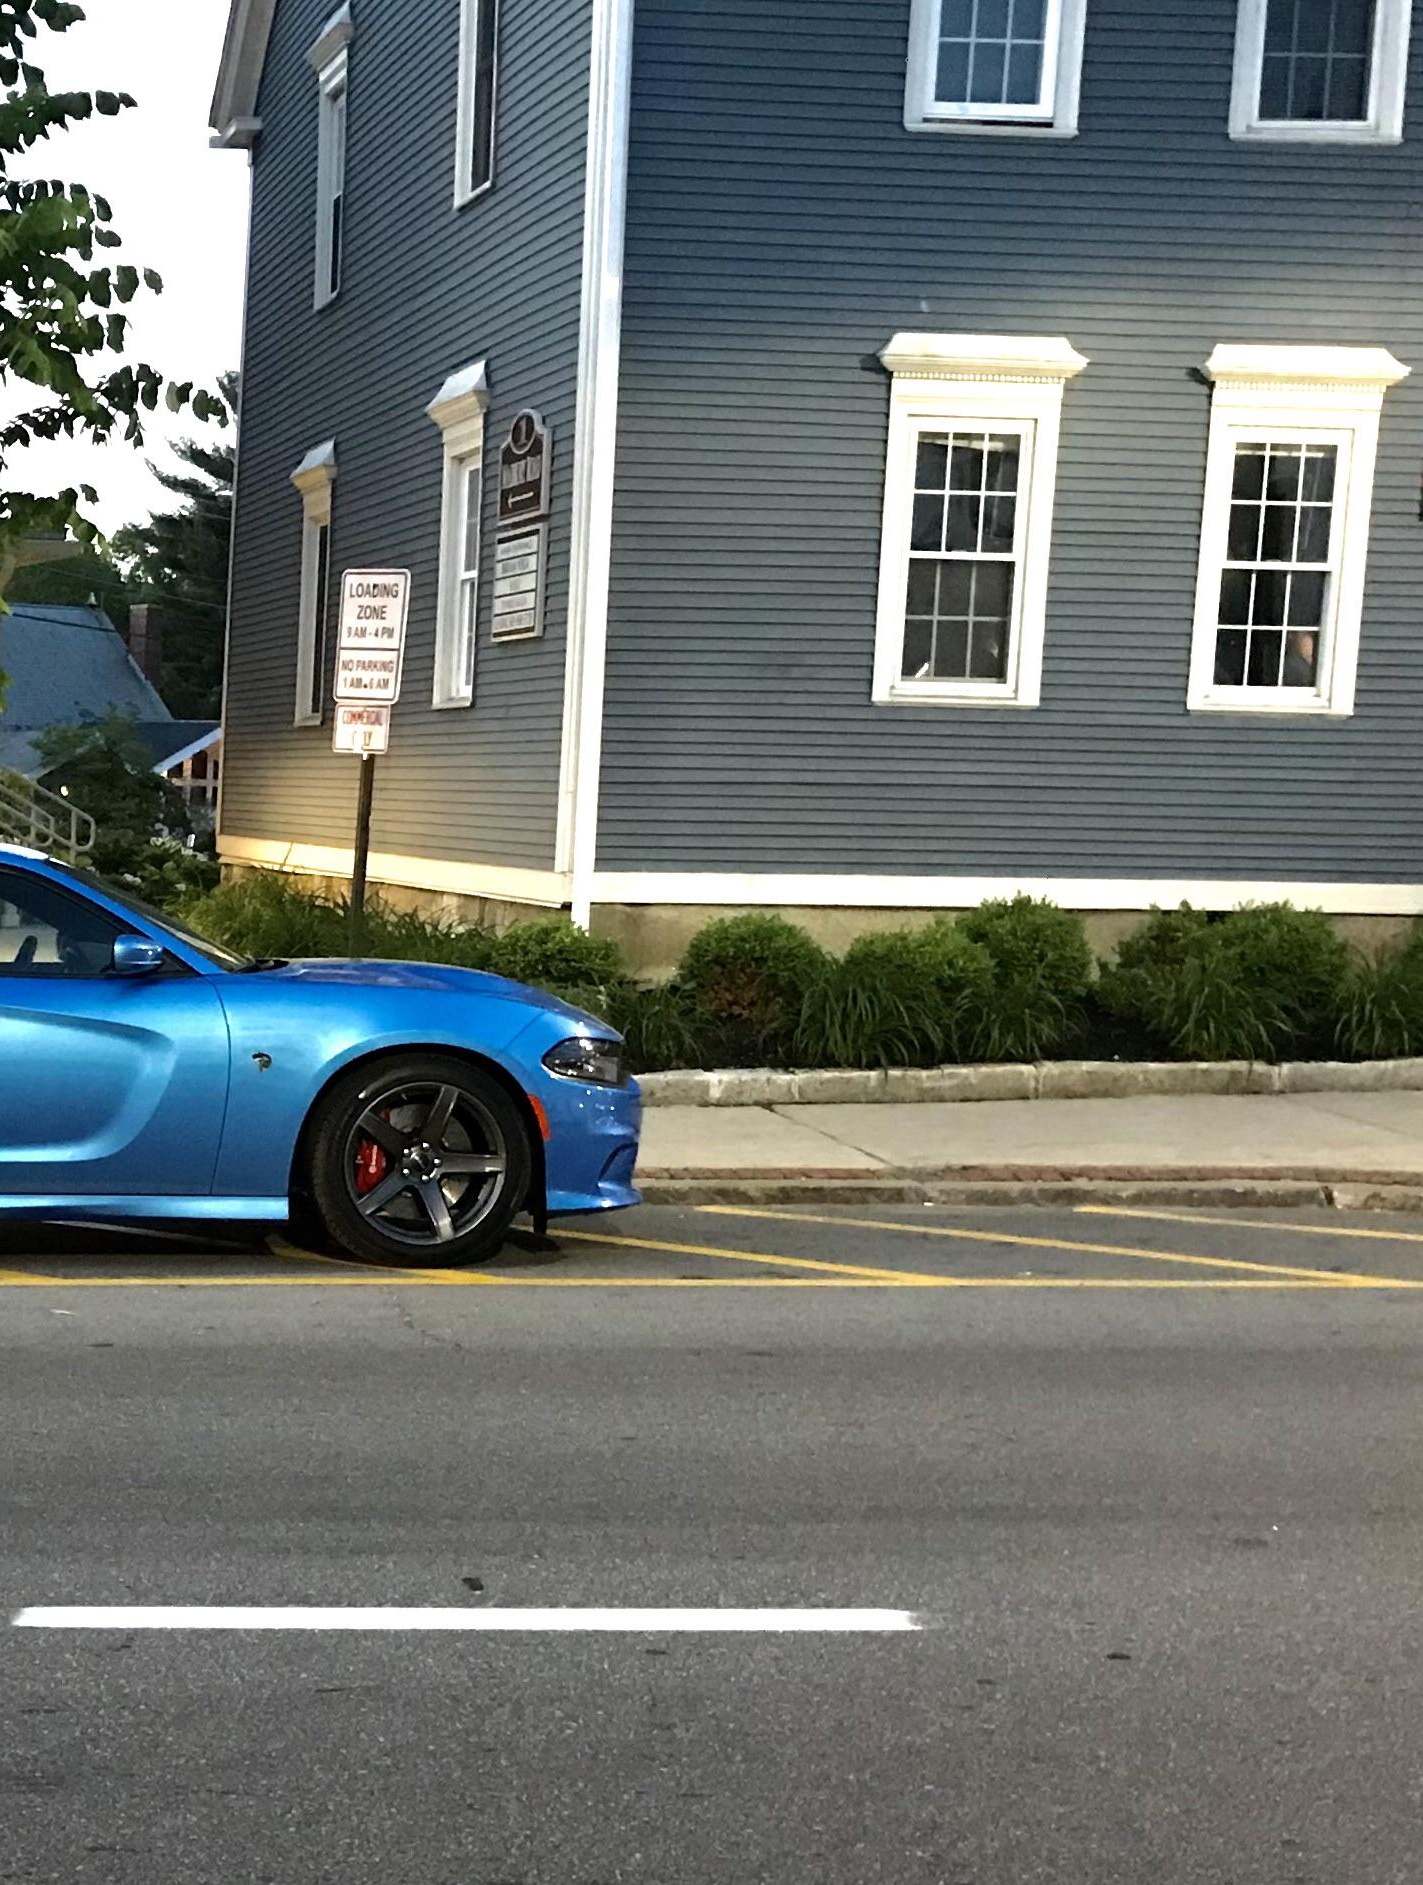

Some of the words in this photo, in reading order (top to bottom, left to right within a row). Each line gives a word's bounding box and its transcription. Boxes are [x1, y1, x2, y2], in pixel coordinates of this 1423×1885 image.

[349, 583, 399, 598] LOADING
[356, 605, 387, 620] ZONE
[347, 627, 352, 638] 9
[353, 627, 367, 638] AM
[374, 627, 379, 638] 4
[381, 626, 394, 639] PM
[341, 660, 354, 672] NO
[356, 660, 394, 673] PARKING
[349, 677, 362, 689] AM
[375, 678, 389, 690] AM
